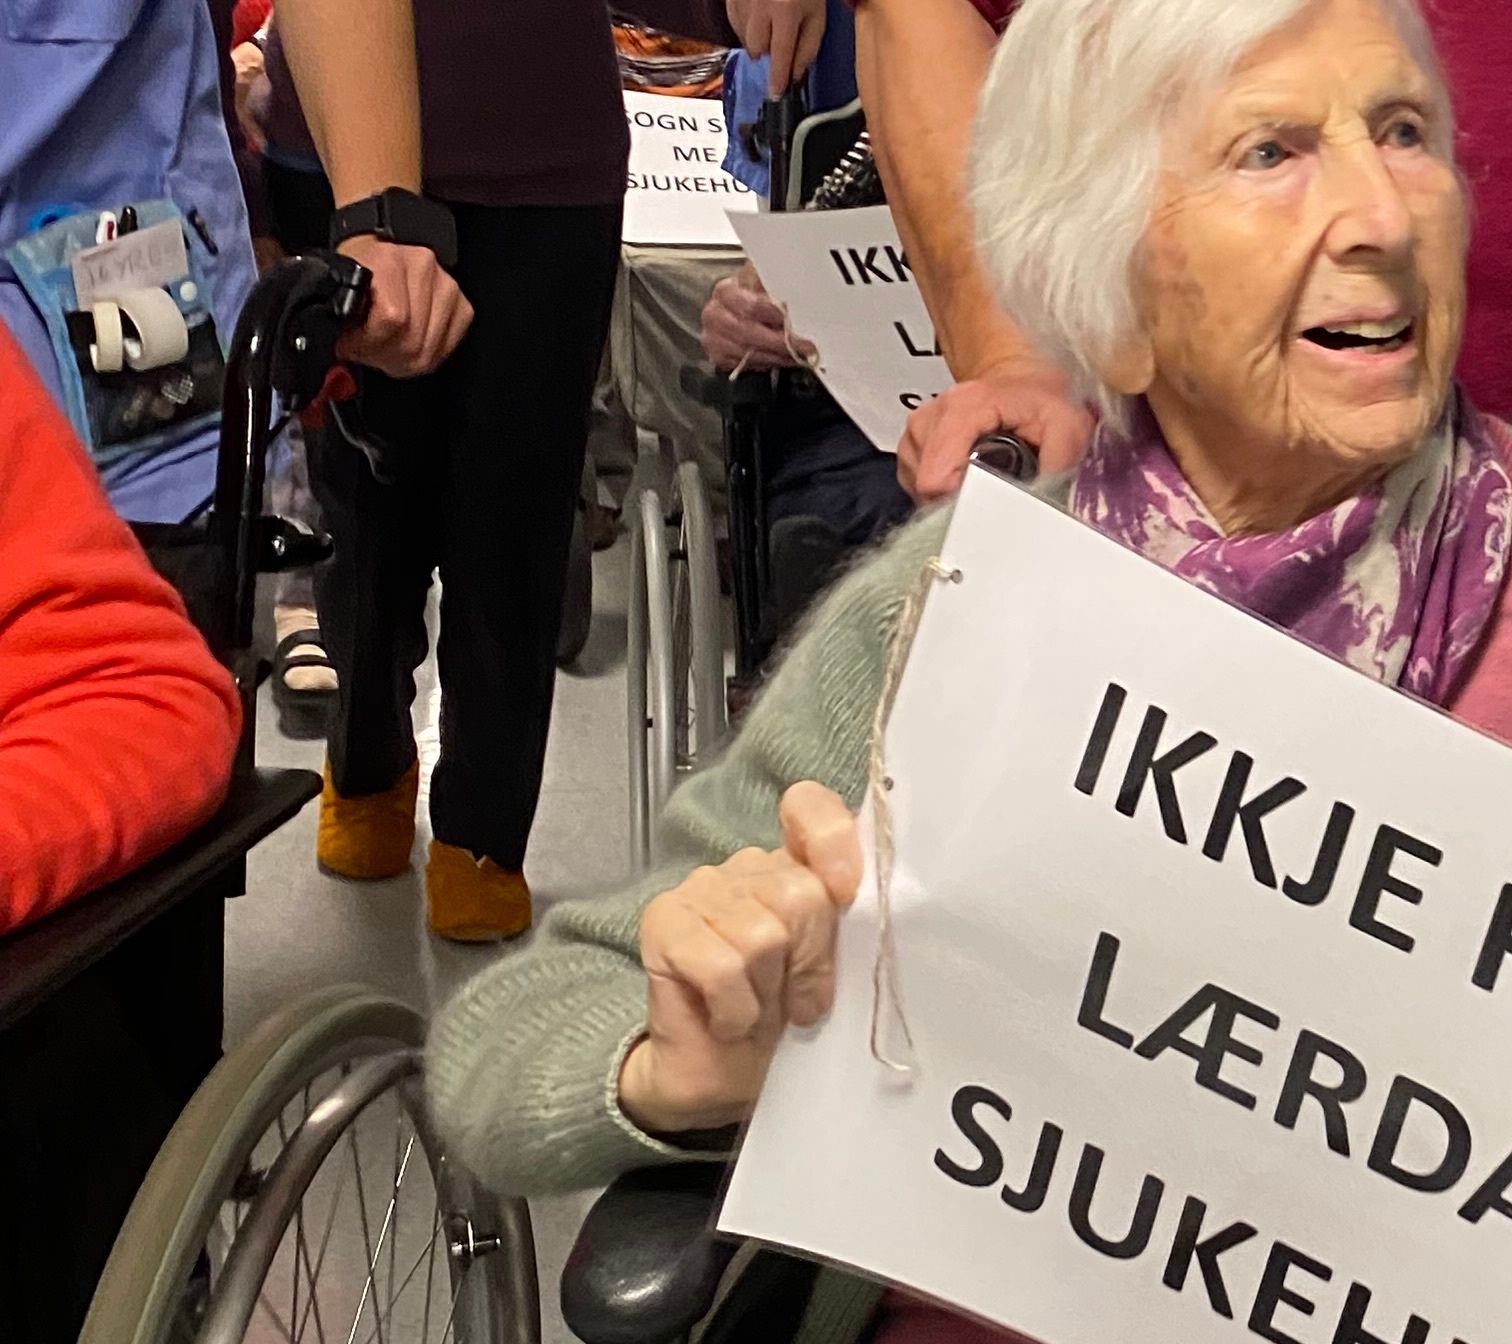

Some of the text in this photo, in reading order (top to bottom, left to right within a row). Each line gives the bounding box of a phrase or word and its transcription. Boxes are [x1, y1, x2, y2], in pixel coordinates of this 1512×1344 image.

[626, 172, 750, 194] SJUKEHU
[829, 245, 913, 286] IKK
[1074, 682, 1443, 954] IKKJE
